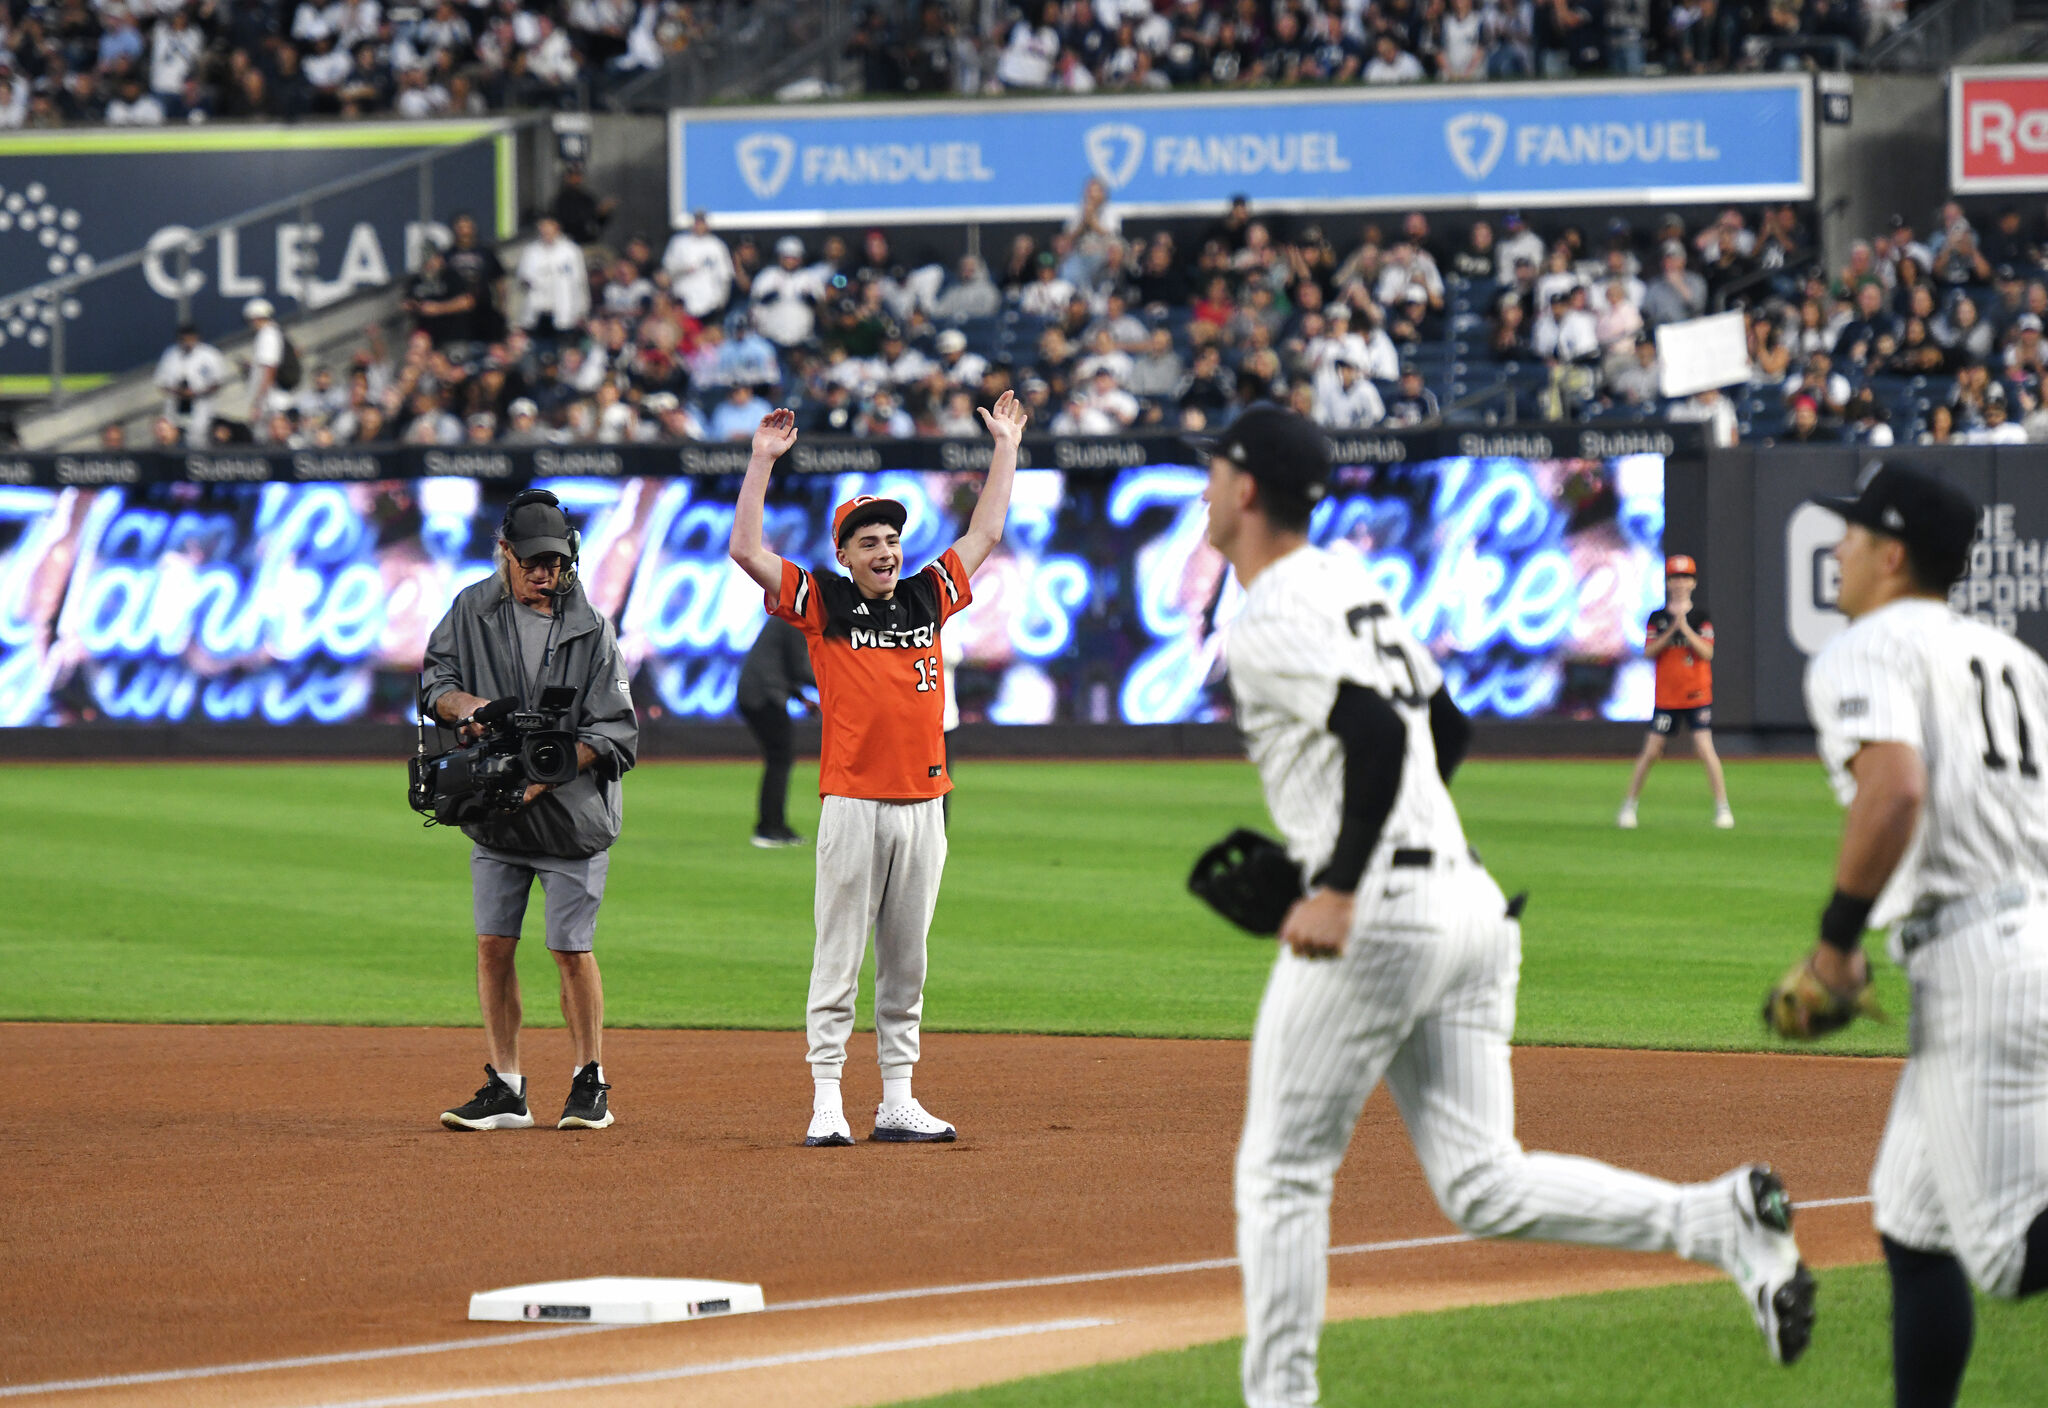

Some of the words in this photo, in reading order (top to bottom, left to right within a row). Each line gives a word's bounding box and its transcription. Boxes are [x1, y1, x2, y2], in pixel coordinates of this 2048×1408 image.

[801, 142, 994, 186] FANDUEL
[1152, 133, 1351, 176] FANDUEL
[1515, 119, 1720, 166] FANDUEL
[914, 656, 938, 692] 15
[1968, 656, 2039, 780] 11
